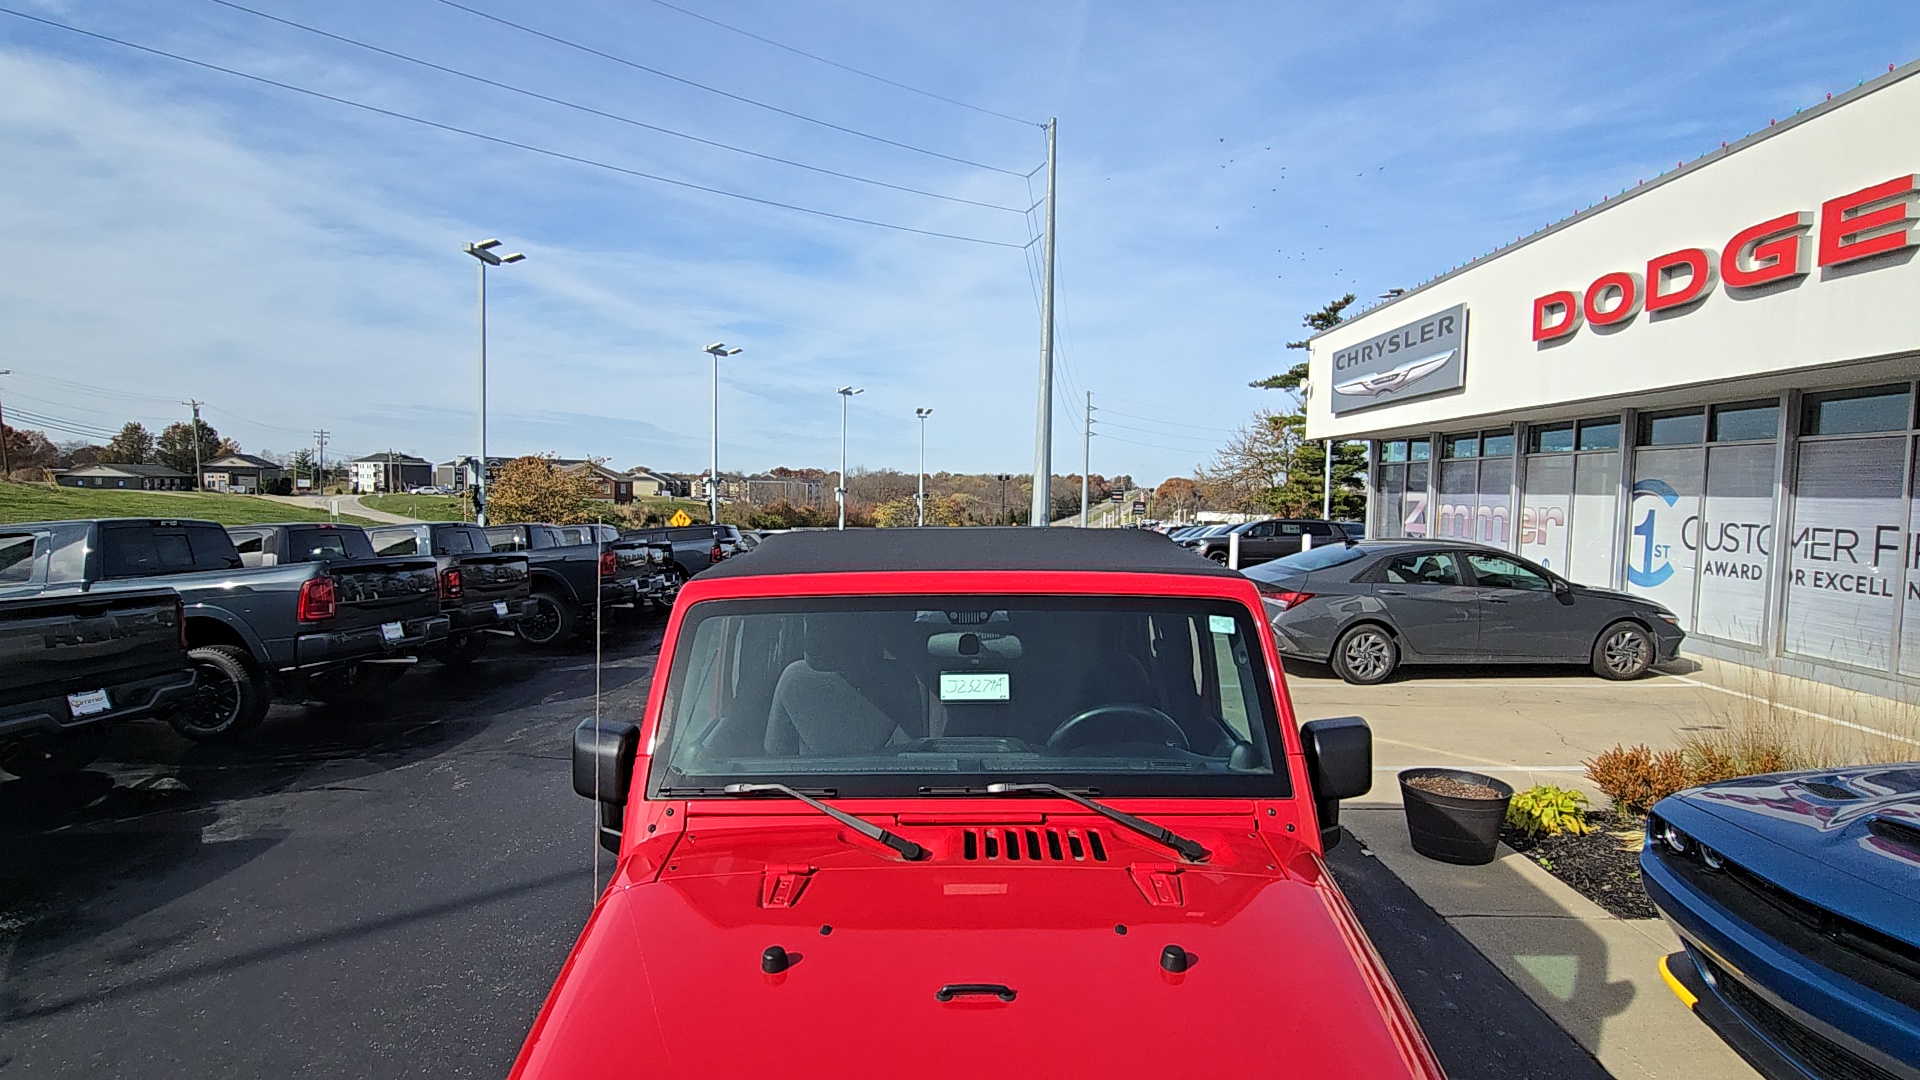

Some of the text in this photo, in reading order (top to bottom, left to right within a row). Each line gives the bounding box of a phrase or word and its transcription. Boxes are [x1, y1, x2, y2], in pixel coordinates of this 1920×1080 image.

[1532, 173, 1915, 342] DODGE
[1335, 315, 1455, 371] CHRYSLER
[1404, 499, 1564, 546] Zmmer
[1703, 560, 1763, 581] AWARD
